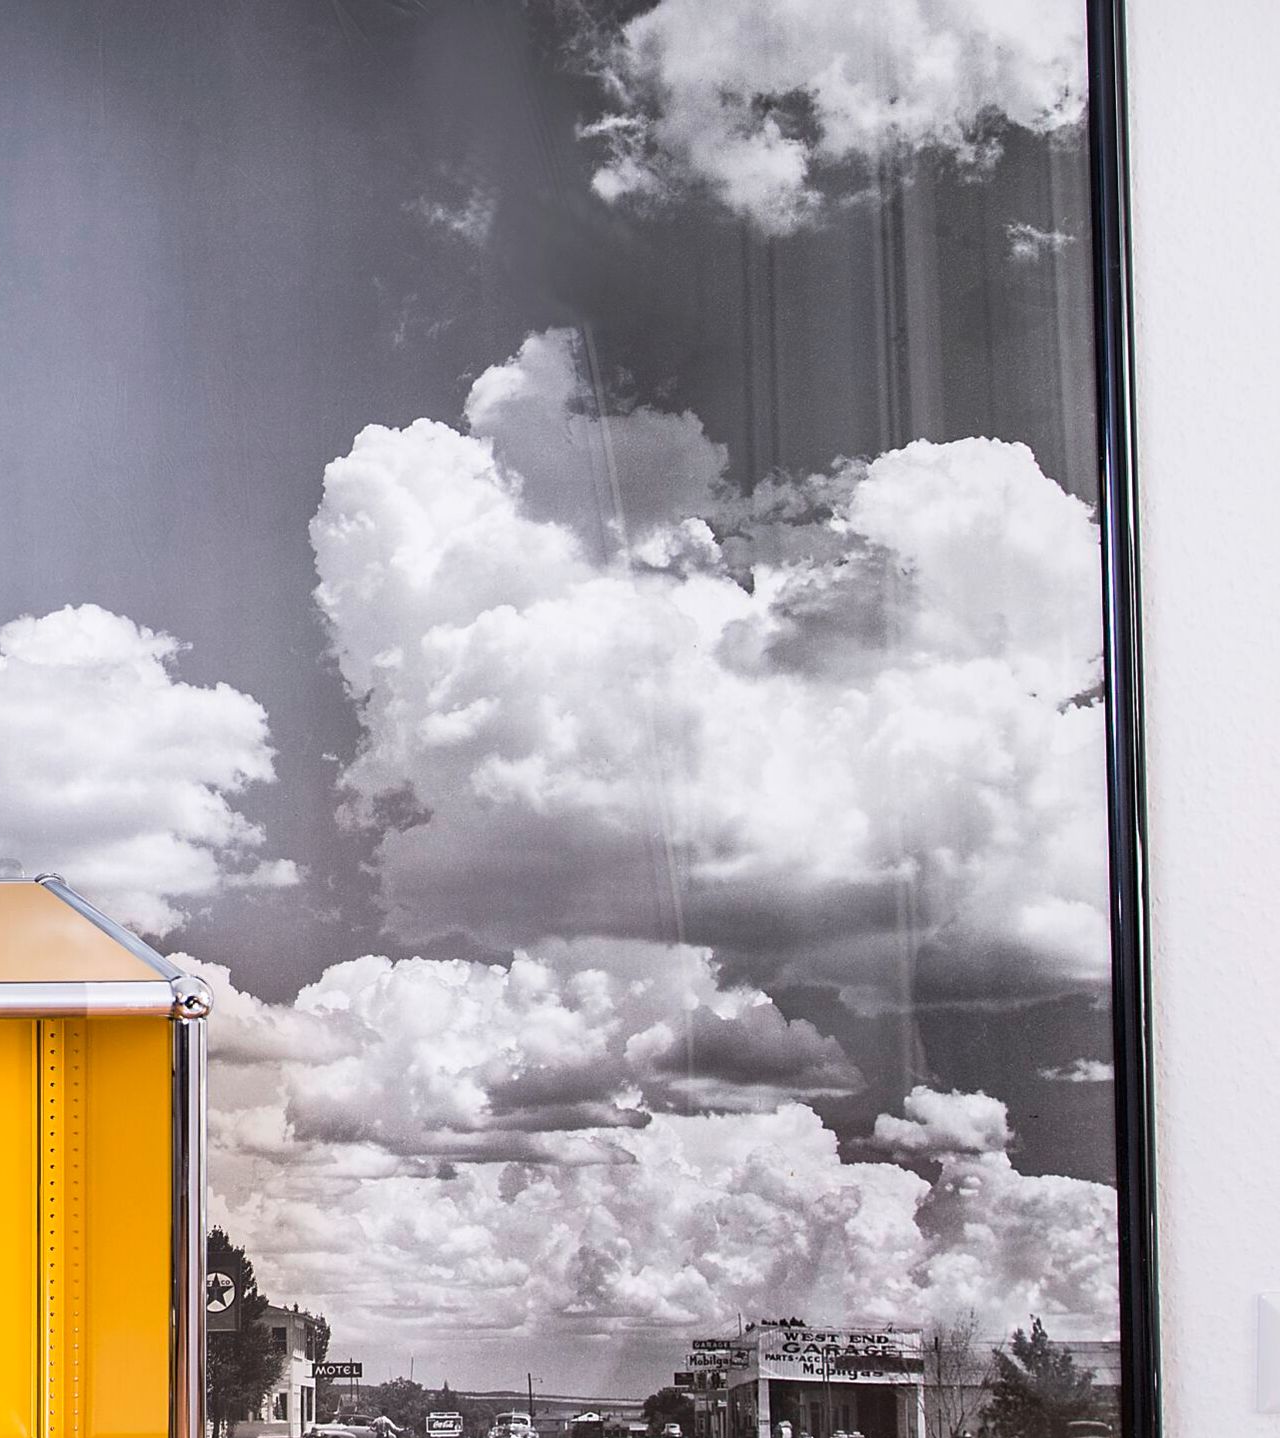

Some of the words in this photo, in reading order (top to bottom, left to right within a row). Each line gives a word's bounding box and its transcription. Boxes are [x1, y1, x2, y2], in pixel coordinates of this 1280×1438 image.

[784, 1333, 840, 1343] WEST
[849, 1334, 889, 1344] END
[782, 1342, 897, 1357] GARAGE
[690, 1354, 733, 1368] Mobilga
[314, 1365, 361, 1376] MOTEL
